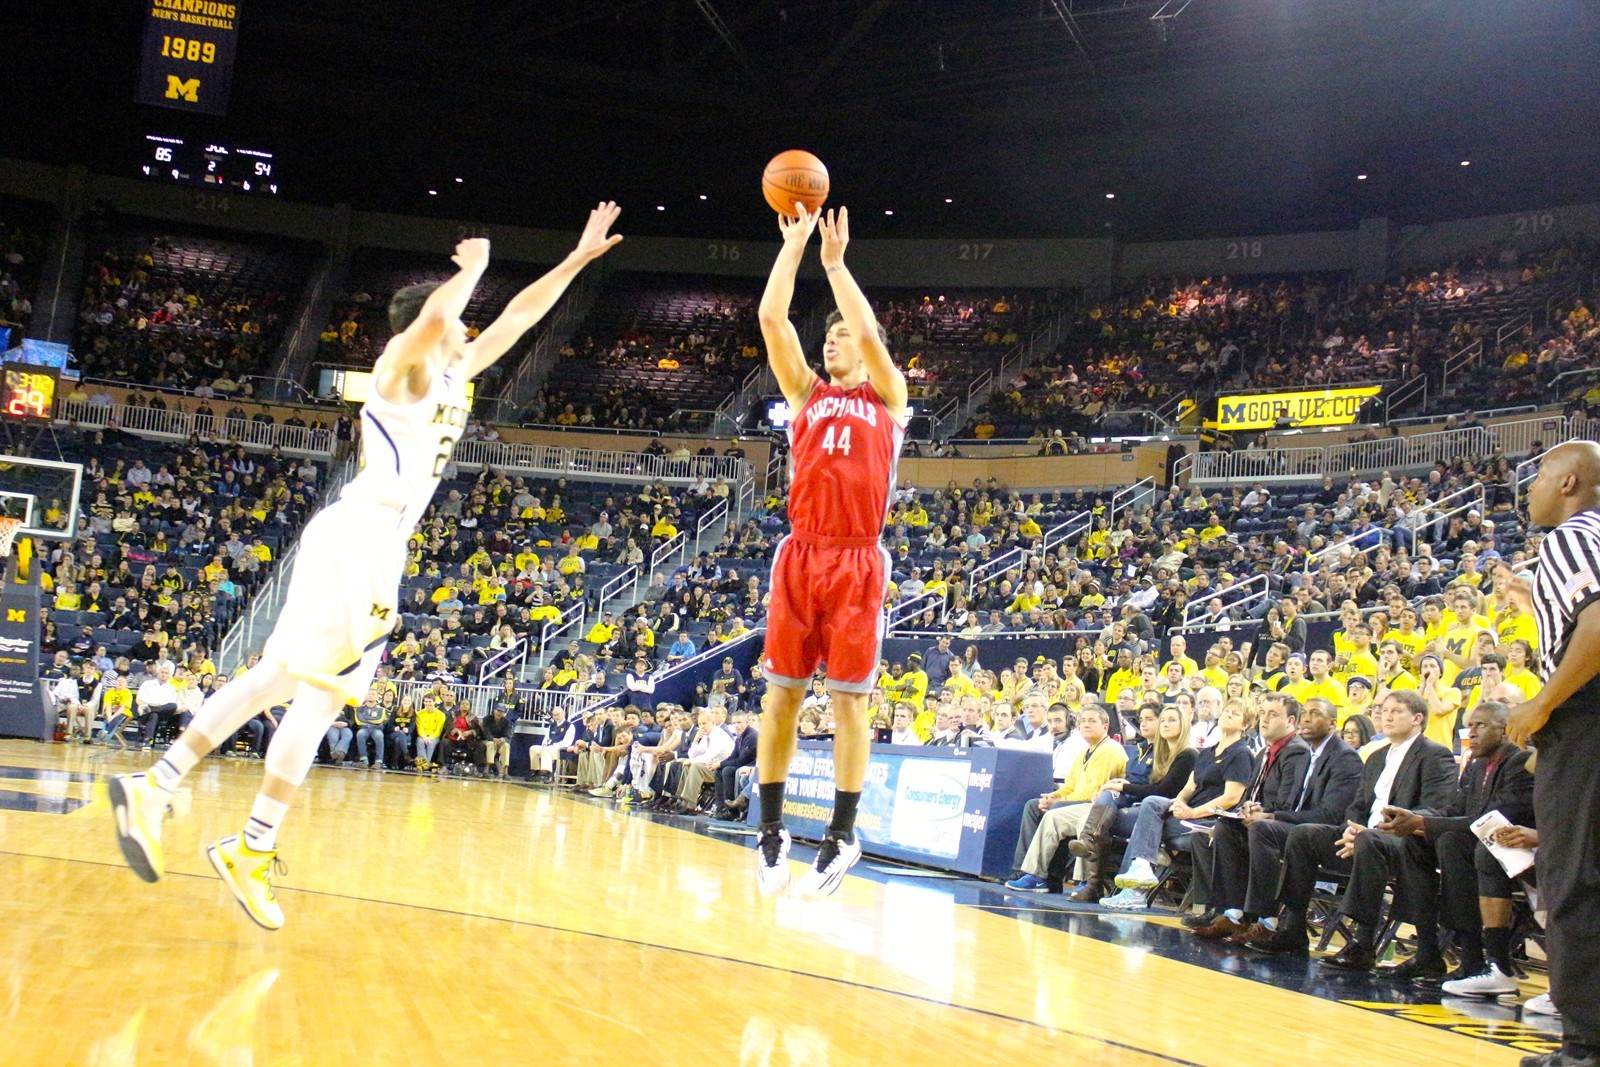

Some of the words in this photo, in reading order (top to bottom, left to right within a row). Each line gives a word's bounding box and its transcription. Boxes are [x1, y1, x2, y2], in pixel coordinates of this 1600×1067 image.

[152, 8, 178, 21] MEN'S
[180, 12, 234, 30] BASKETBALL
[153, 0, 236, 19] CHAMPIONS
[161, 35, 216, 64] 1989
[164, 74, 201, 103] M
[155, 146, 172, 162] 85
[208, 161, 216, 172] 2
[254, 161, 272, 176] 54
[1515, 214, 1554, 236] 219
[707, 243, 740, 261] 216
[959, 243, 994, 260] 217
[1226, 241, 1262, 259] 218
[1221, 403, 1246, 424] M
[1249, 396, 1366, 422] GOBLUE.CO
[821, 425, 851, 456] 44
[7, 608, 27, 622] M
[369, 602, 390, 621] M
[1446, 638, 1467, 655] M
[813, 758, 835, 778] EFFIC
[866, 762, 889, 783] ATES
[784, 777, 799, 796] FOR
[798, 778, 817, 798] YOUR
[816, 780, 836, 800] BUSI
[938, 789, 961, 810] Energy
